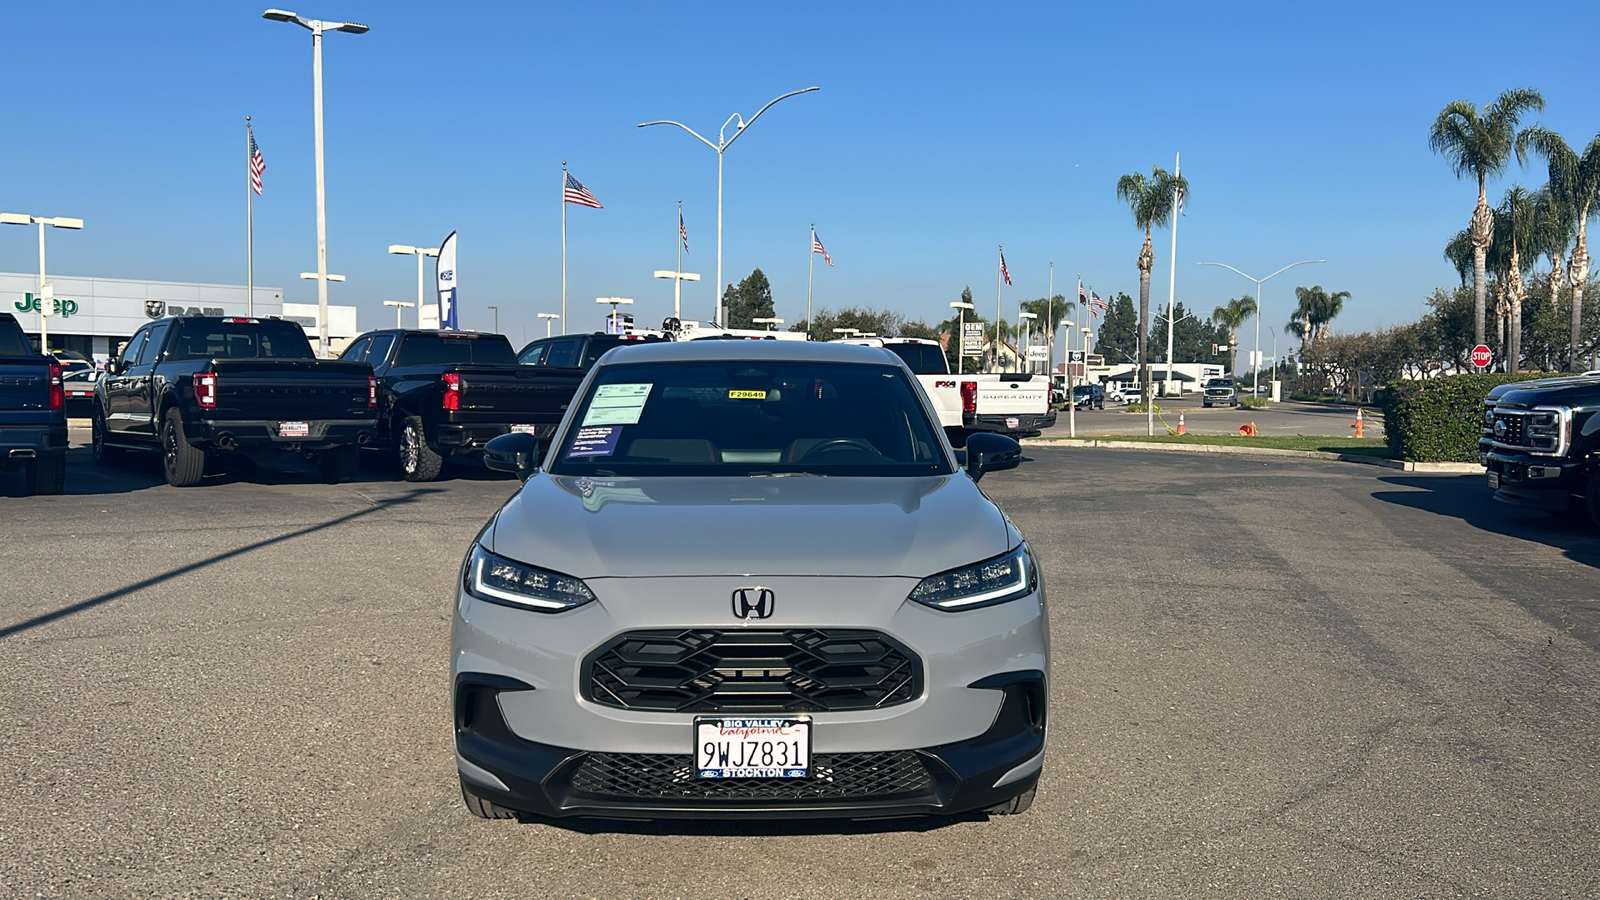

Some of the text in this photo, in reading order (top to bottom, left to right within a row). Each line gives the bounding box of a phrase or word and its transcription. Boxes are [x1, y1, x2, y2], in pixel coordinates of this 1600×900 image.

[1029, 350, 1047, 358] Jeep
[1473, 351, 1490, 361] STOP
[935, 380, 956, 388] FX4
[719, 727, 790, 739] California
[703, 741, 803, 768] 9WJZ831
[722, 769, 784, 778] STOCKTON
